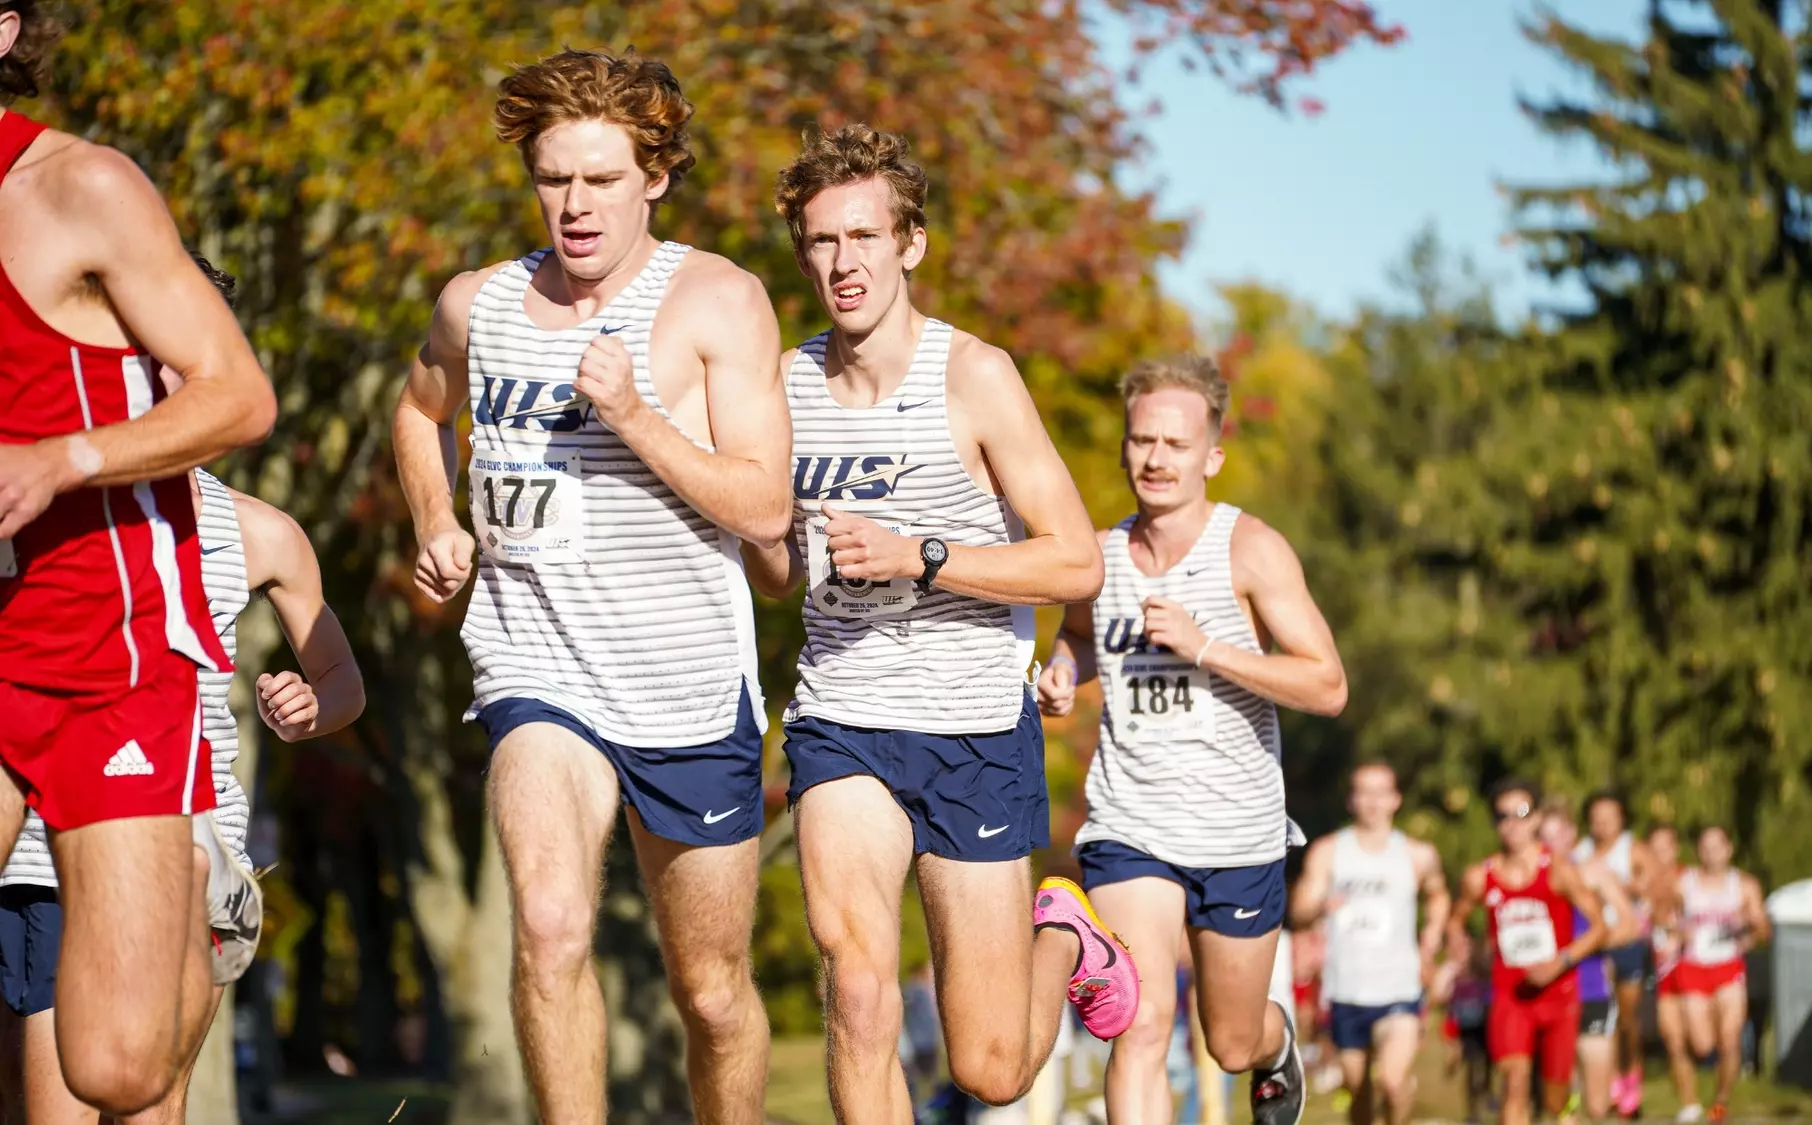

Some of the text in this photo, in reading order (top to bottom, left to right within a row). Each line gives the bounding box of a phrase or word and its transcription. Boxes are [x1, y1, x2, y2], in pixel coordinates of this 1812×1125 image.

[475, 376, 588, 432] UIS
[487, 460, 501, 471] GLVC
[503, 461, 568, 472] CHAMPIONSHIPS
[794, 455, 906, 500] UIS
[483, 476, 557, 529] 177
[1127, 675, 1195, 715] 184
[103, 761, 155, 777] adidas
